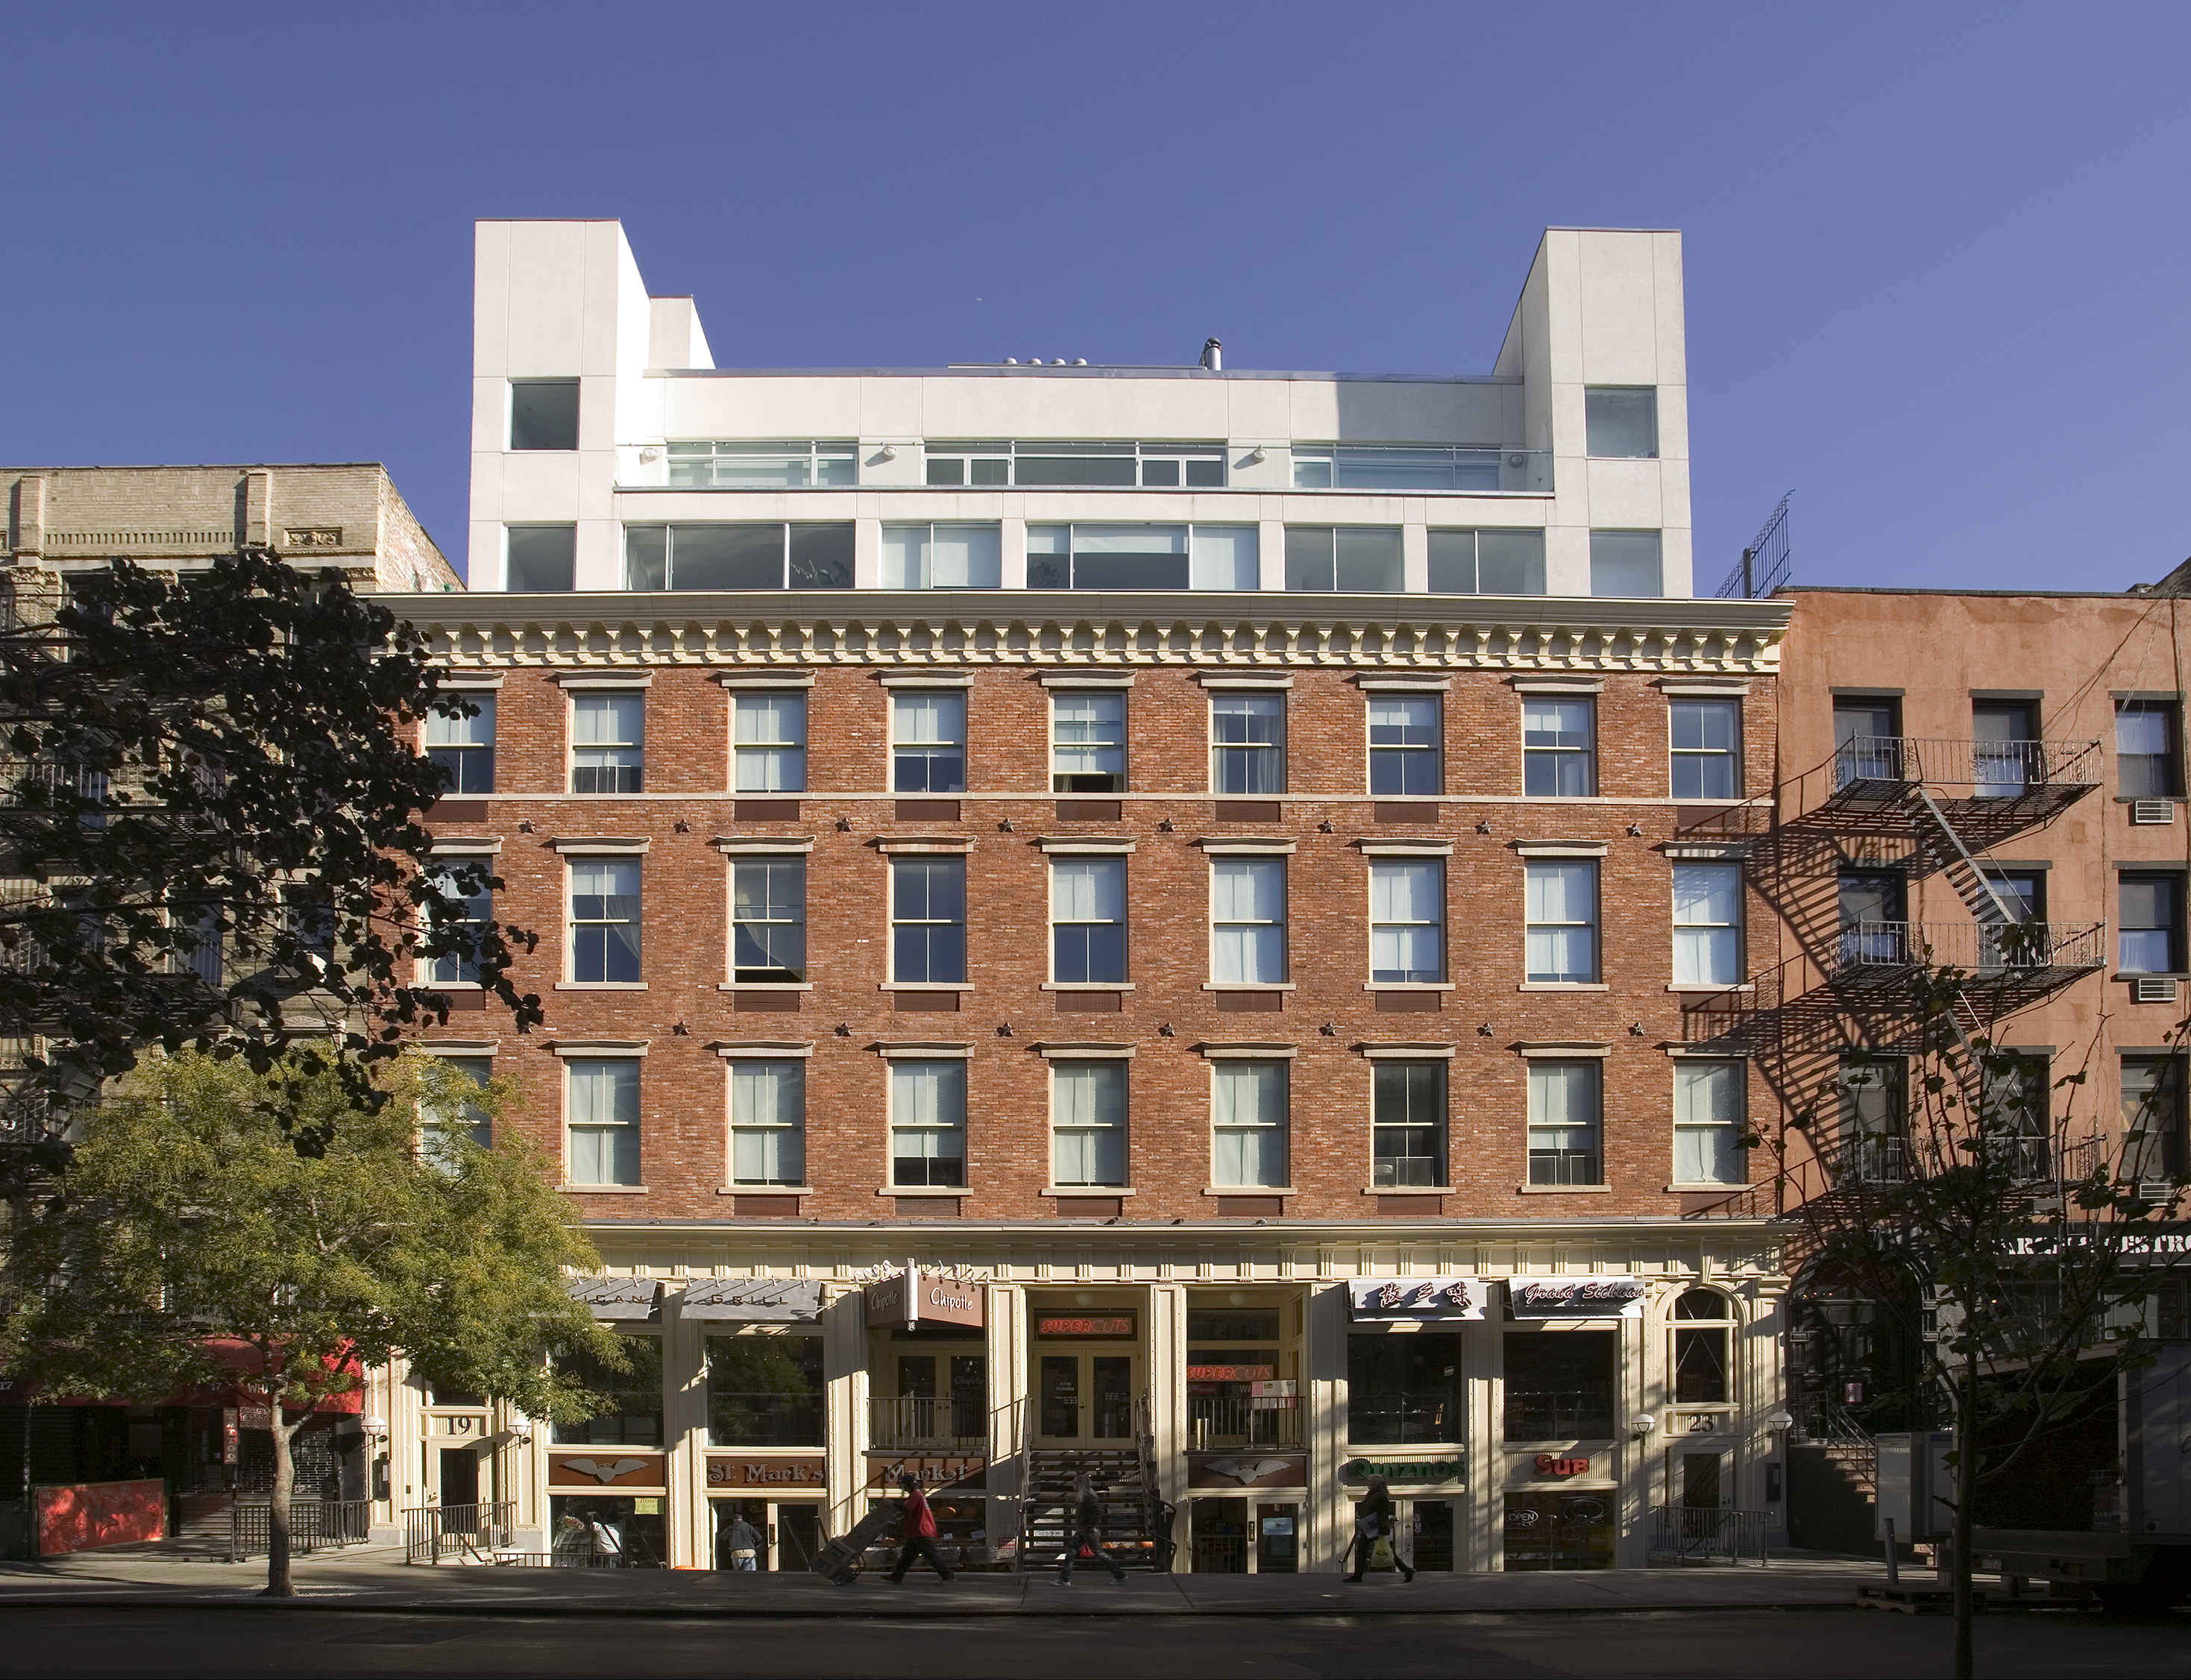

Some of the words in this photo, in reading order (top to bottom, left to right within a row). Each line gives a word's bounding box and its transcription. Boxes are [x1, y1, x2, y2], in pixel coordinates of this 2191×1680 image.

[711, 1294, 788, 1304] GRILL
[871, 1290, 899, 1312] Chipotle
[930, 1287, 973, 1312] Chipotle
[1379, 1281, 1471, 1308] 故乡味
[1525, 1282, 1576, 1304] Grand
[1582, 1281, 1644, 1300] Sichuan
[1040, 1319, 1129, 1333] SUPERCUTS
[210, 1382, 222, 1391] 17
[954, 1375, 984, 1387] Chipotle
[447, 1416, 471, 1435] 19
[1688, 1413, 1714, 1432] 23
[225, 1412, 236, 1460] TATTOO
[708, 1463, 736, 1482] St.
[745, 1463, 823, 1482] Mark's
[884, 1464, 968, 1482] Market
[1508, 1513, 1535, 1522] OPEN
